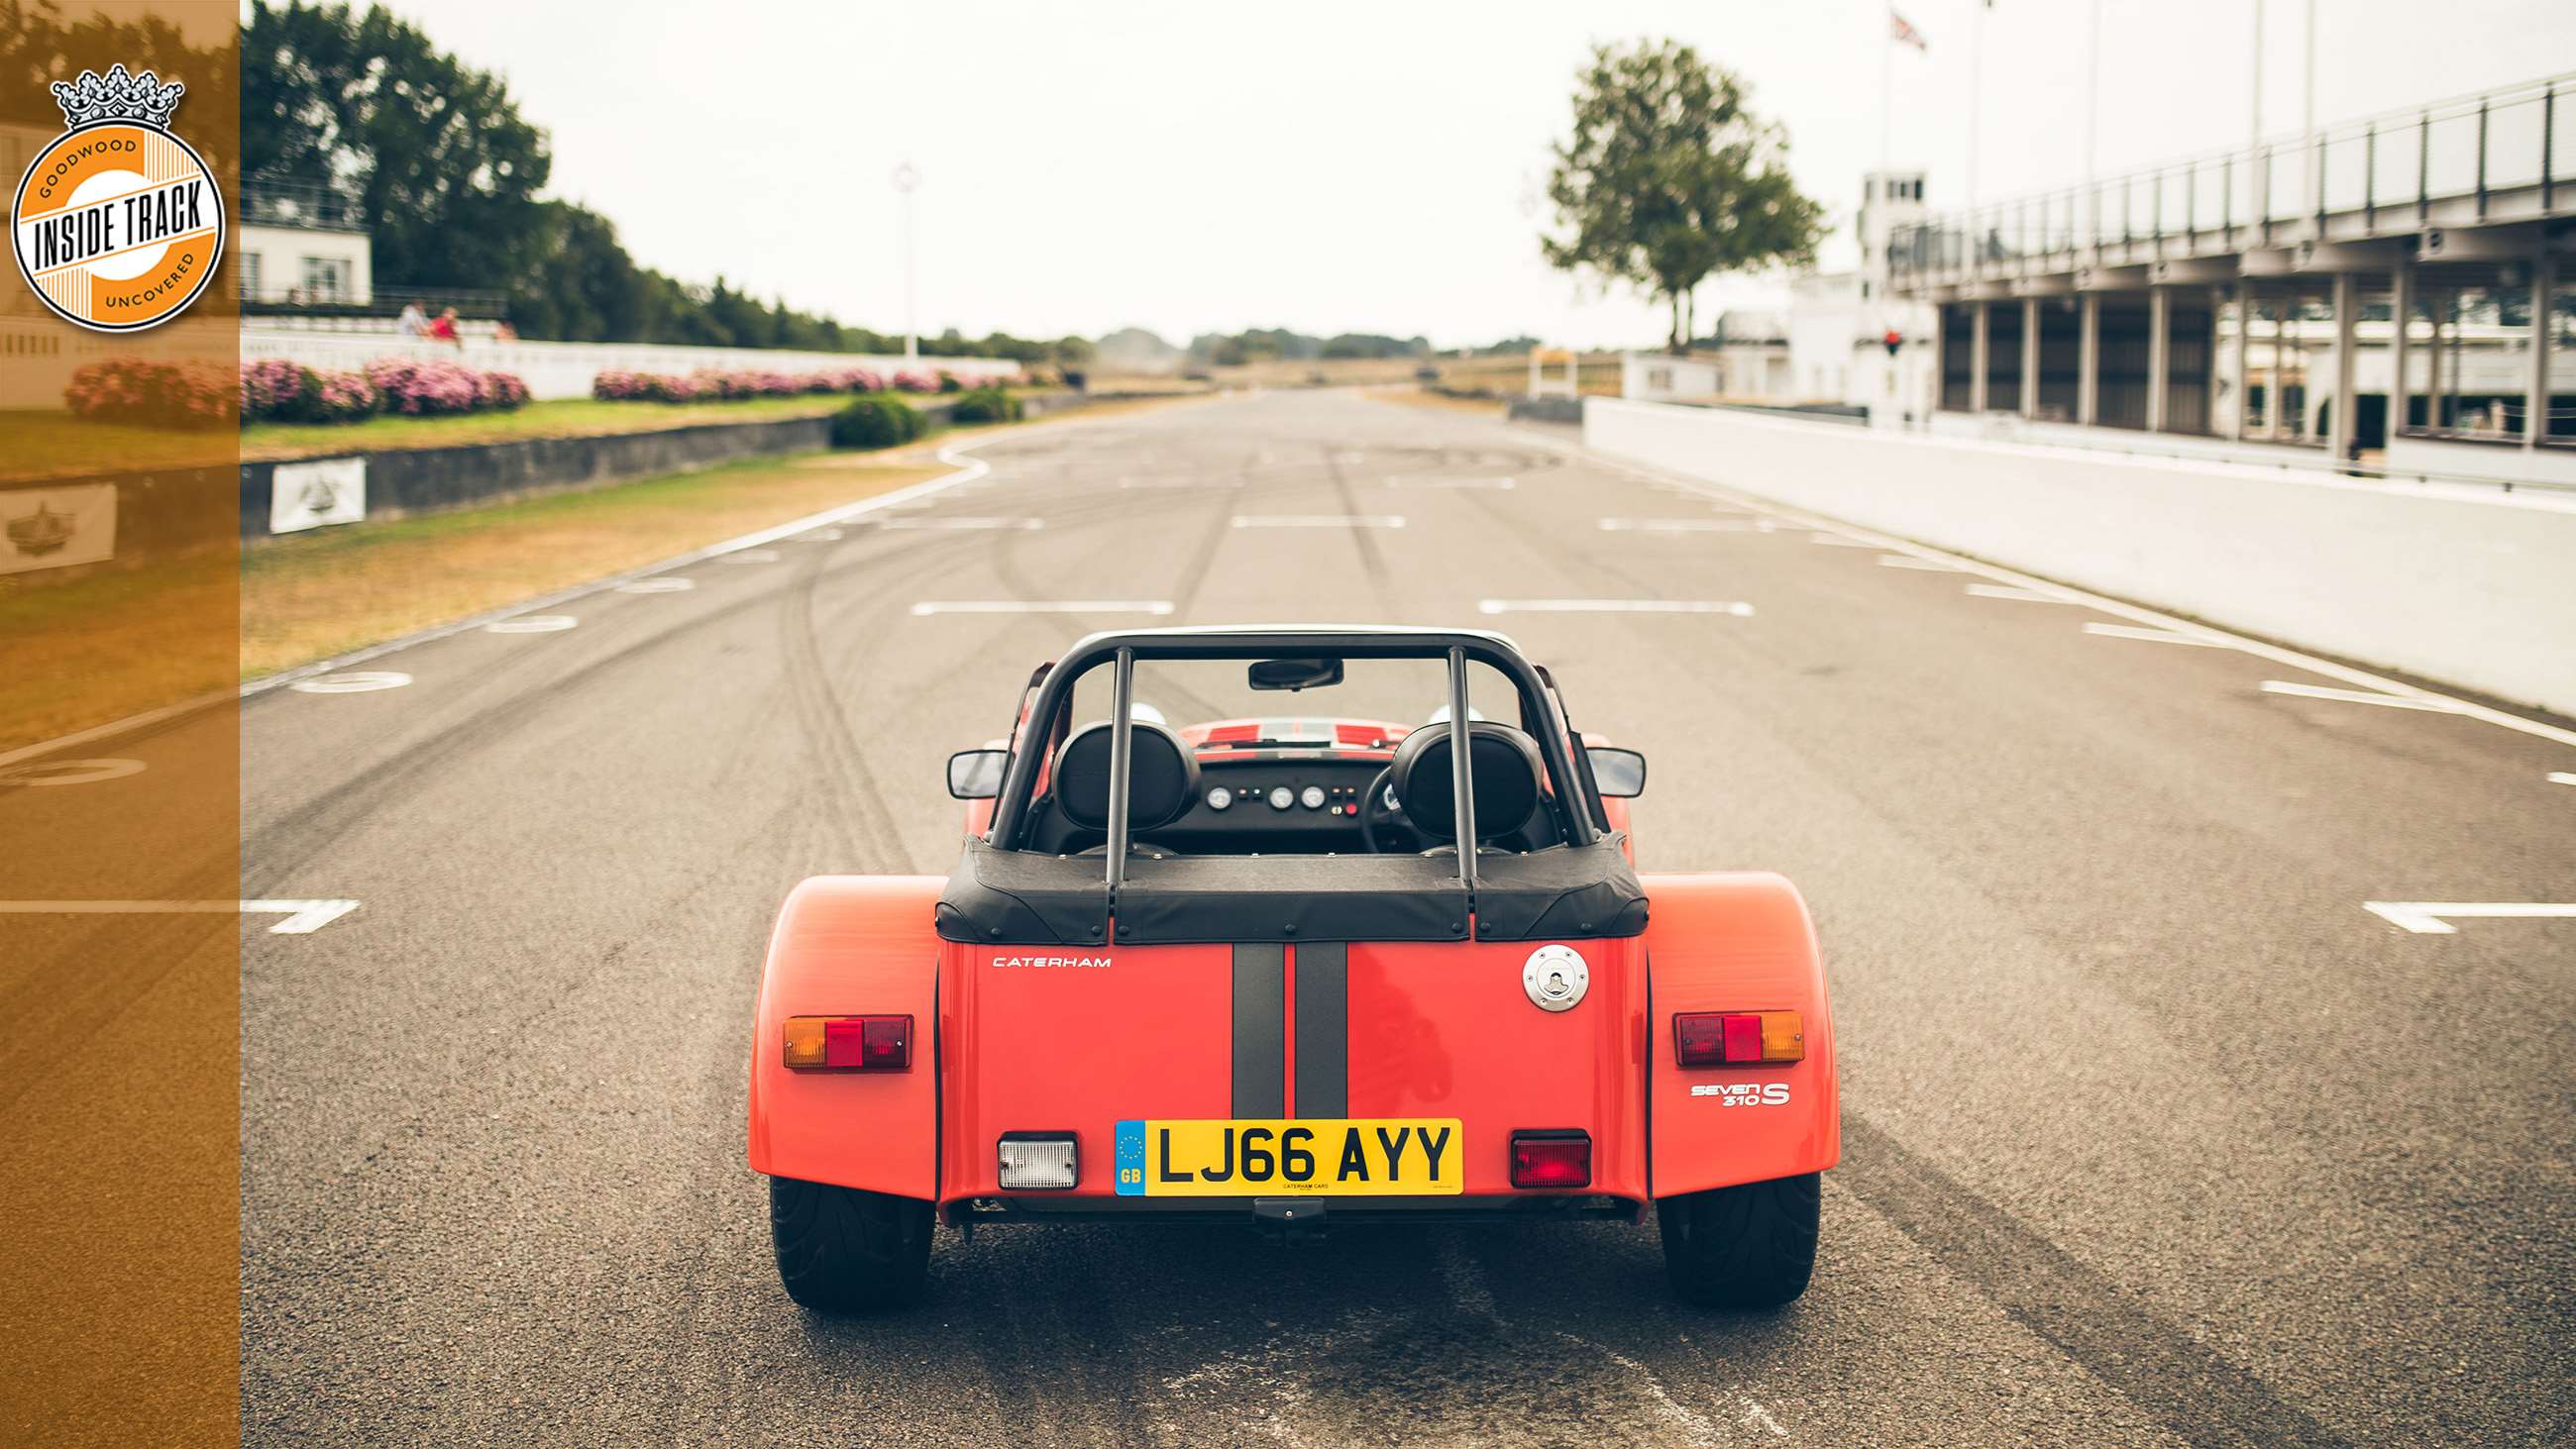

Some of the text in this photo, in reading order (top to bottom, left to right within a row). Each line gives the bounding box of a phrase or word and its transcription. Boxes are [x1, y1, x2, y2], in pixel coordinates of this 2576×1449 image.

[992, 957, 1112, 968] CATERHAM
[1722, 1094, 1760, 1106] 310
[1761, 1083, 1790, 1105] S
[1159, 1126, 1451, 1183] LJ66 AYY
[1120, 1168, 1141, 1184] GB
